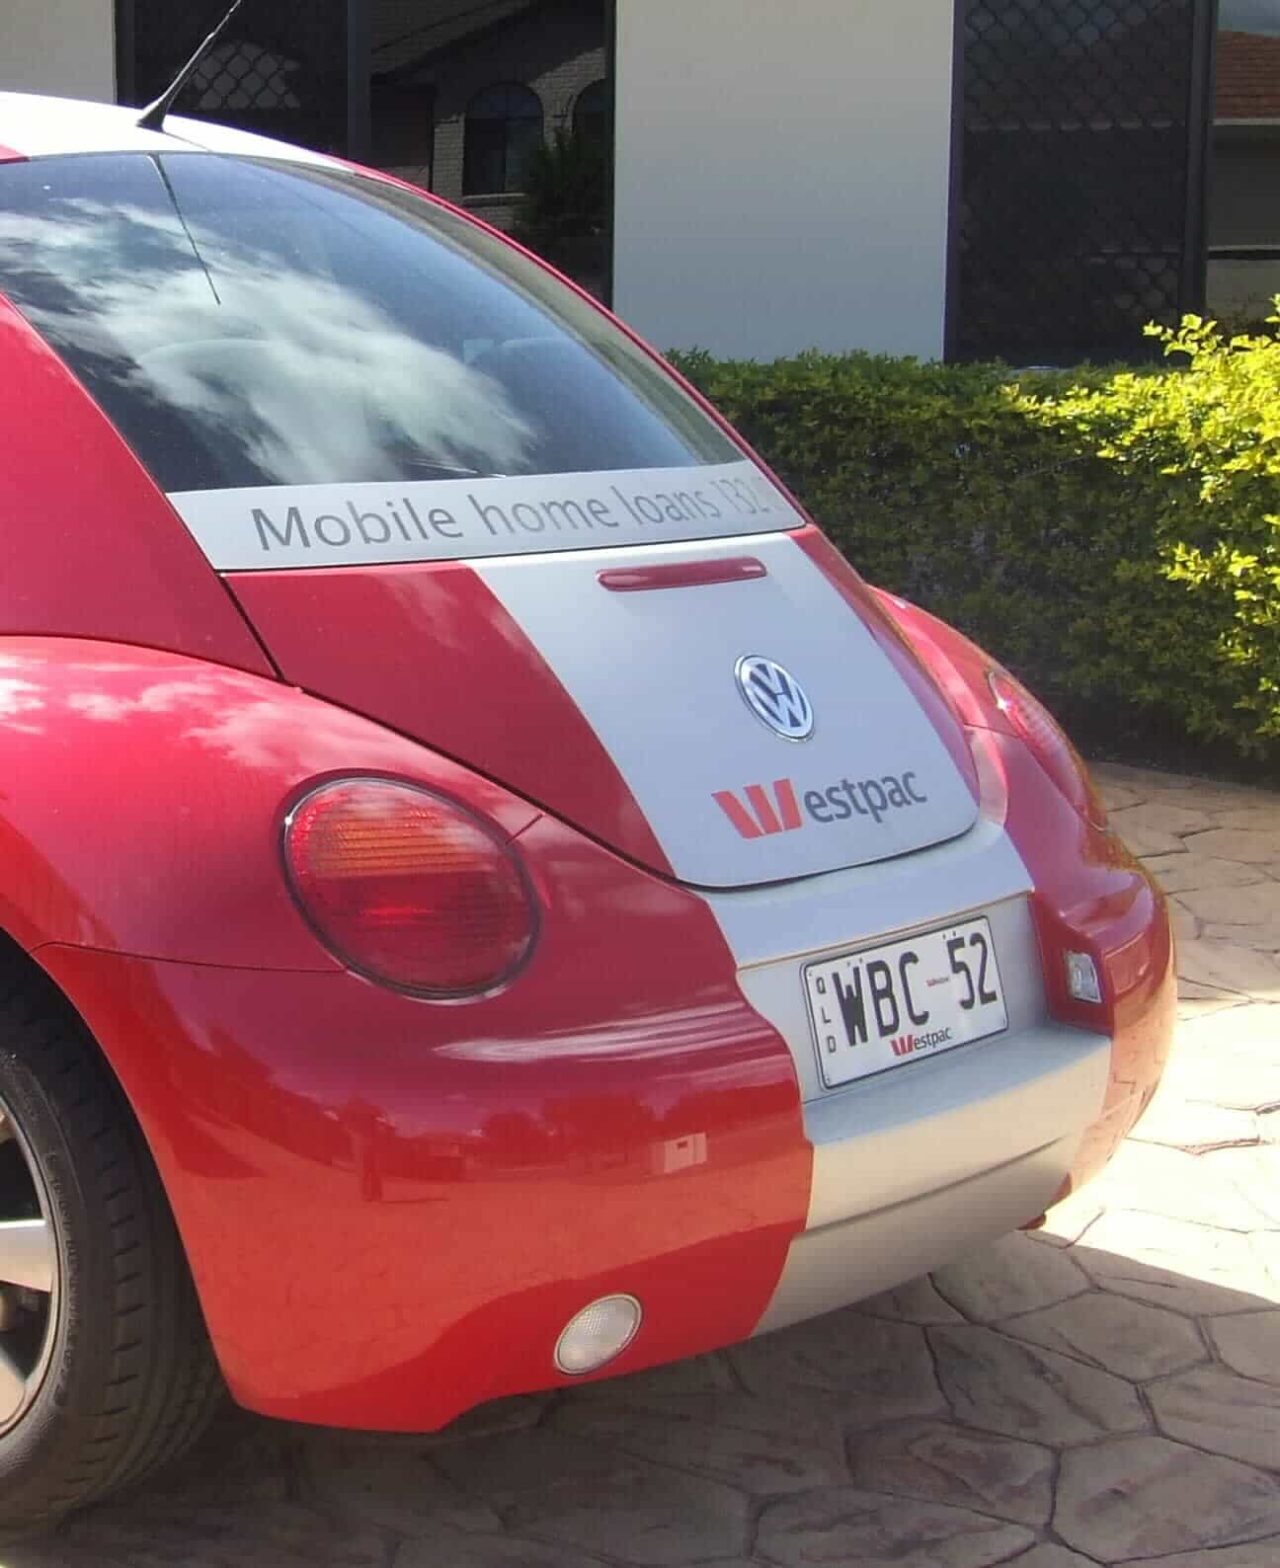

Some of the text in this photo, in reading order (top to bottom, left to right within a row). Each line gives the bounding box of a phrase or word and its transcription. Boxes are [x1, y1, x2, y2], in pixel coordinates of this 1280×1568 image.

[251, 497, 463, 551] Mobile
[468, 493, 619, 536] home
[610, 485, 719, 525] loans
[711, 772, 928, 839] Westpac
[832, 932, 998, 1046] WBC 52
[890, 1027, 952, 1056] Westpac
